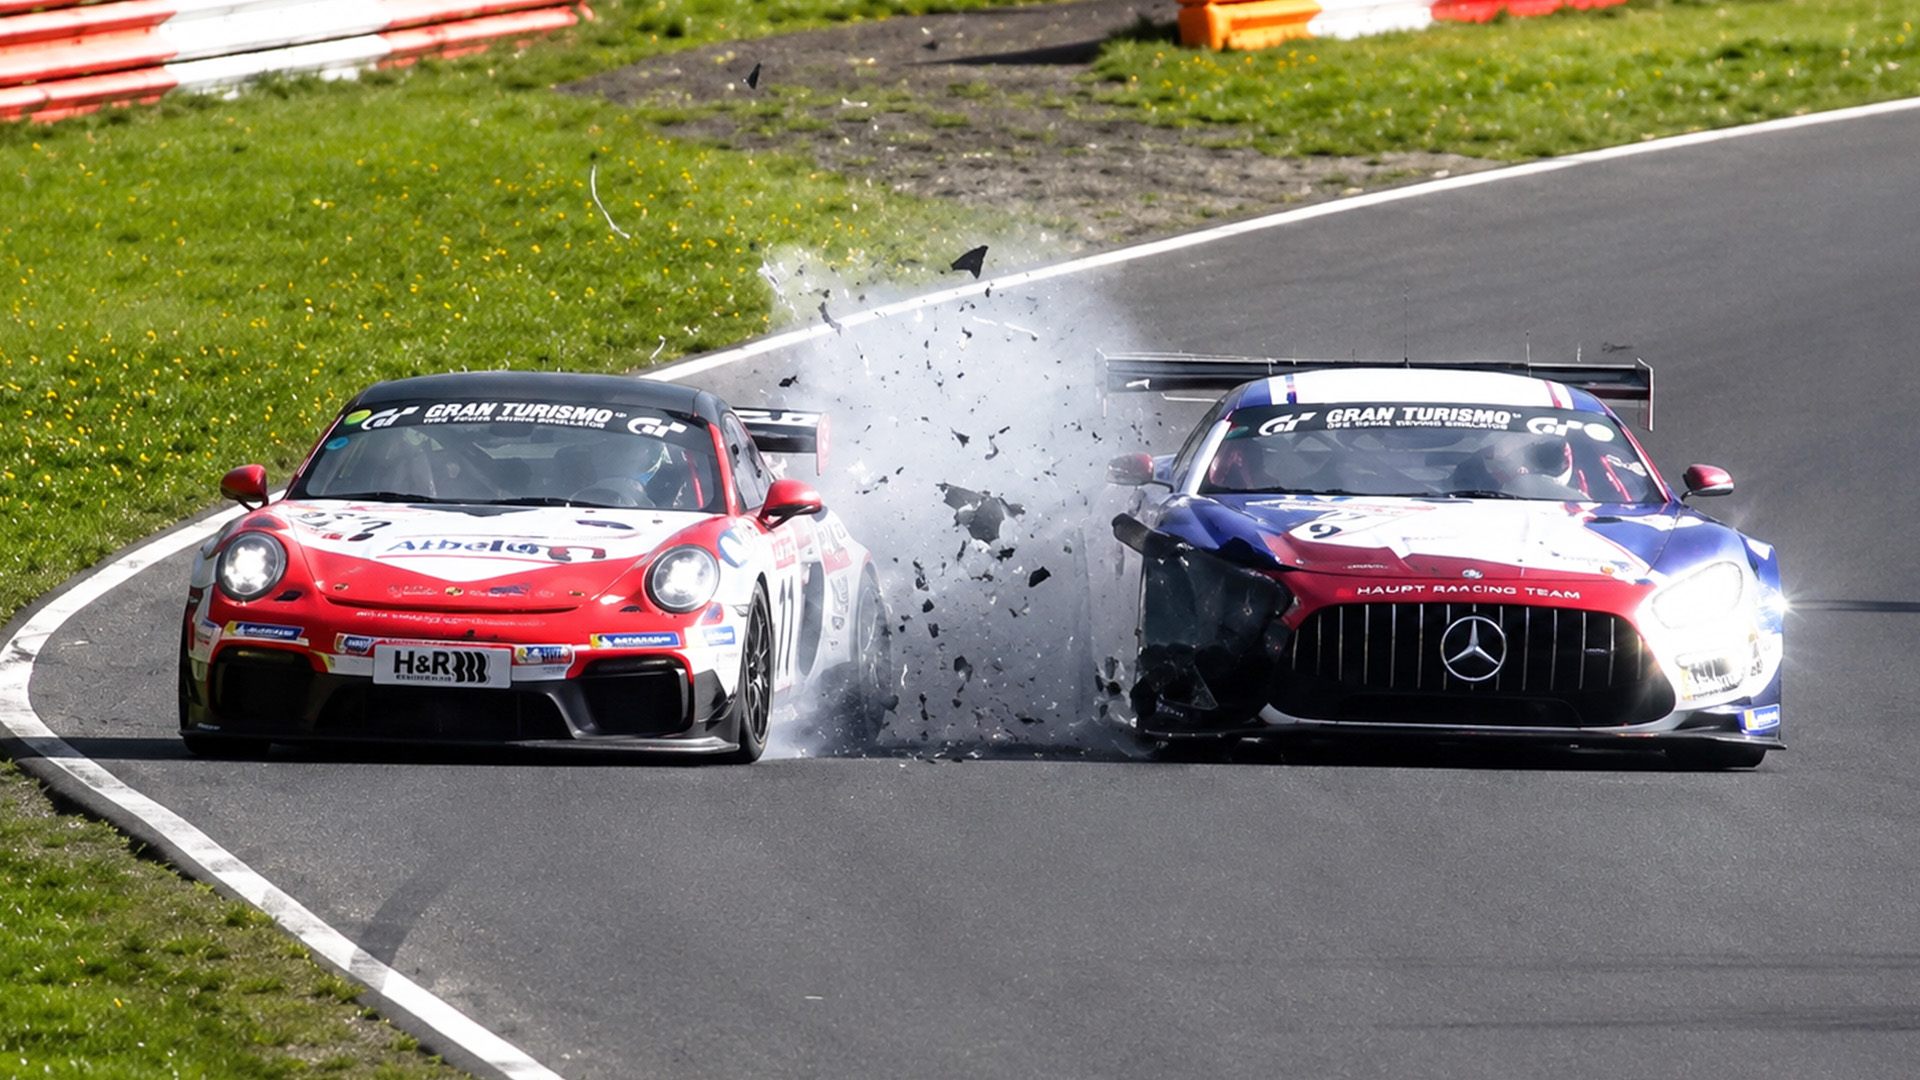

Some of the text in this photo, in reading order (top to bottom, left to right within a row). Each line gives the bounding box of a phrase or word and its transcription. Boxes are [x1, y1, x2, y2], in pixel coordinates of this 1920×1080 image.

[424, 402, 498, 419] GRAN
[502, 402, 614, 423] TURISMO
[1325, 406, 1512, 424] GRAN TURISMO
[1357, 585, 1426, 595] HAUPT
[1525, 587, 1580, 599] TEAM
[393, 650, 453, 675] H&R
